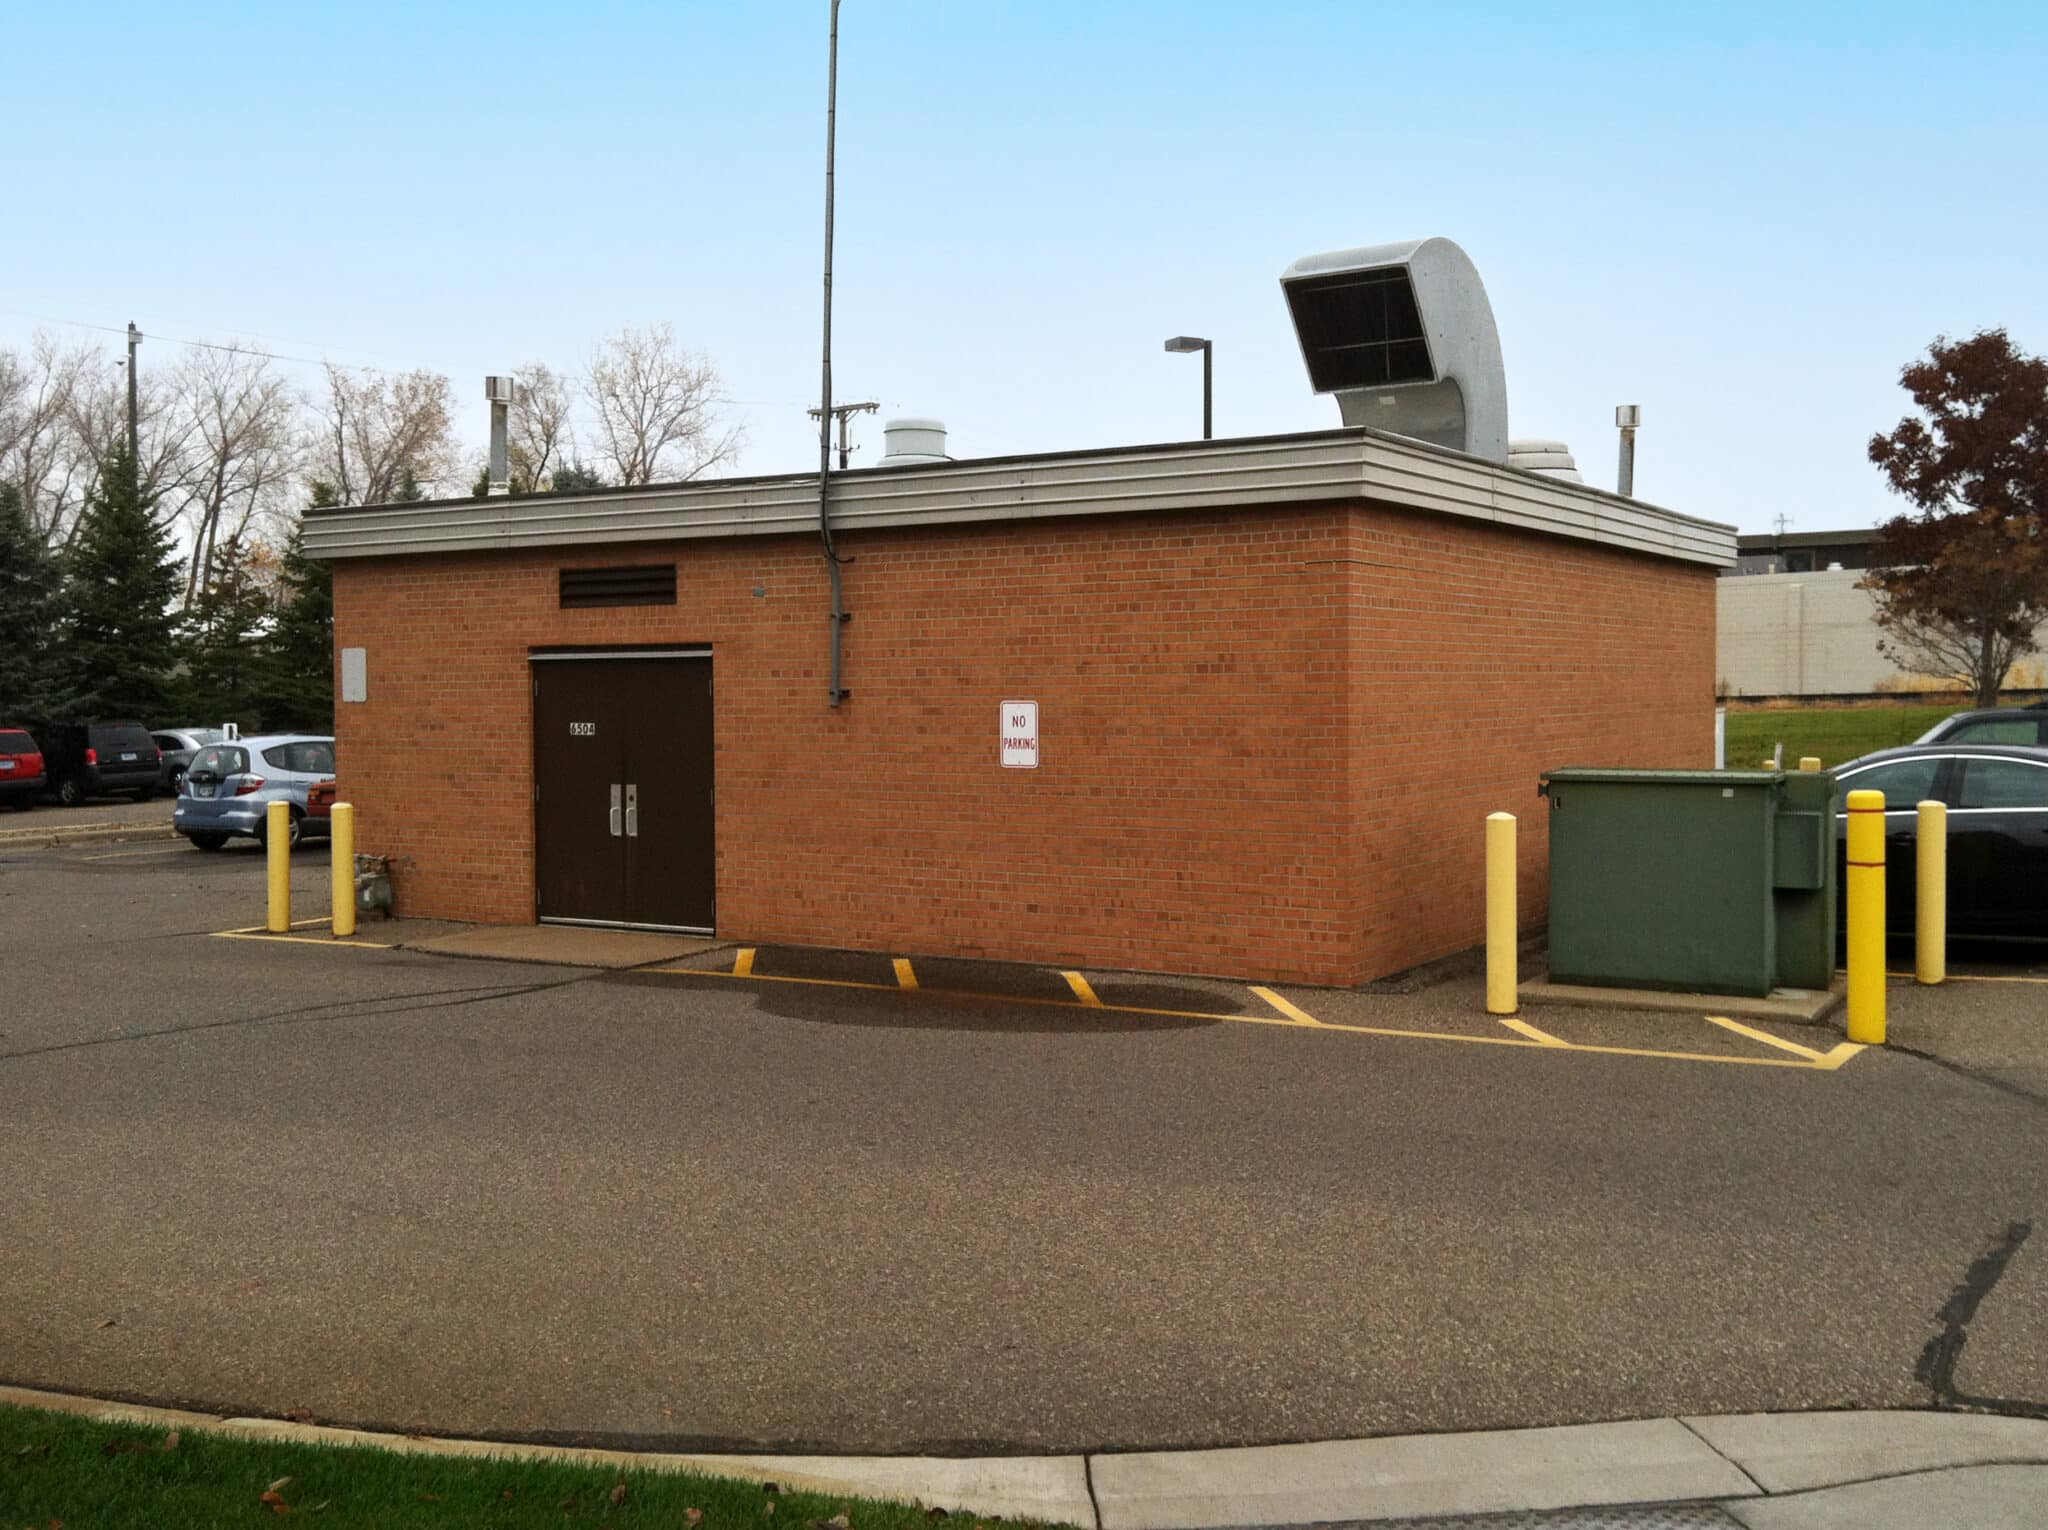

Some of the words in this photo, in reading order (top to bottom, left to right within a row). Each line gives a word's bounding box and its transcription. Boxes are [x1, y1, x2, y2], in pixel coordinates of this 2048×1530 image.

[1012, 715, 1026, 728] NO
[571, 723, 594, 735] 6504
[1004, 738, 1035, 750] PARKING
